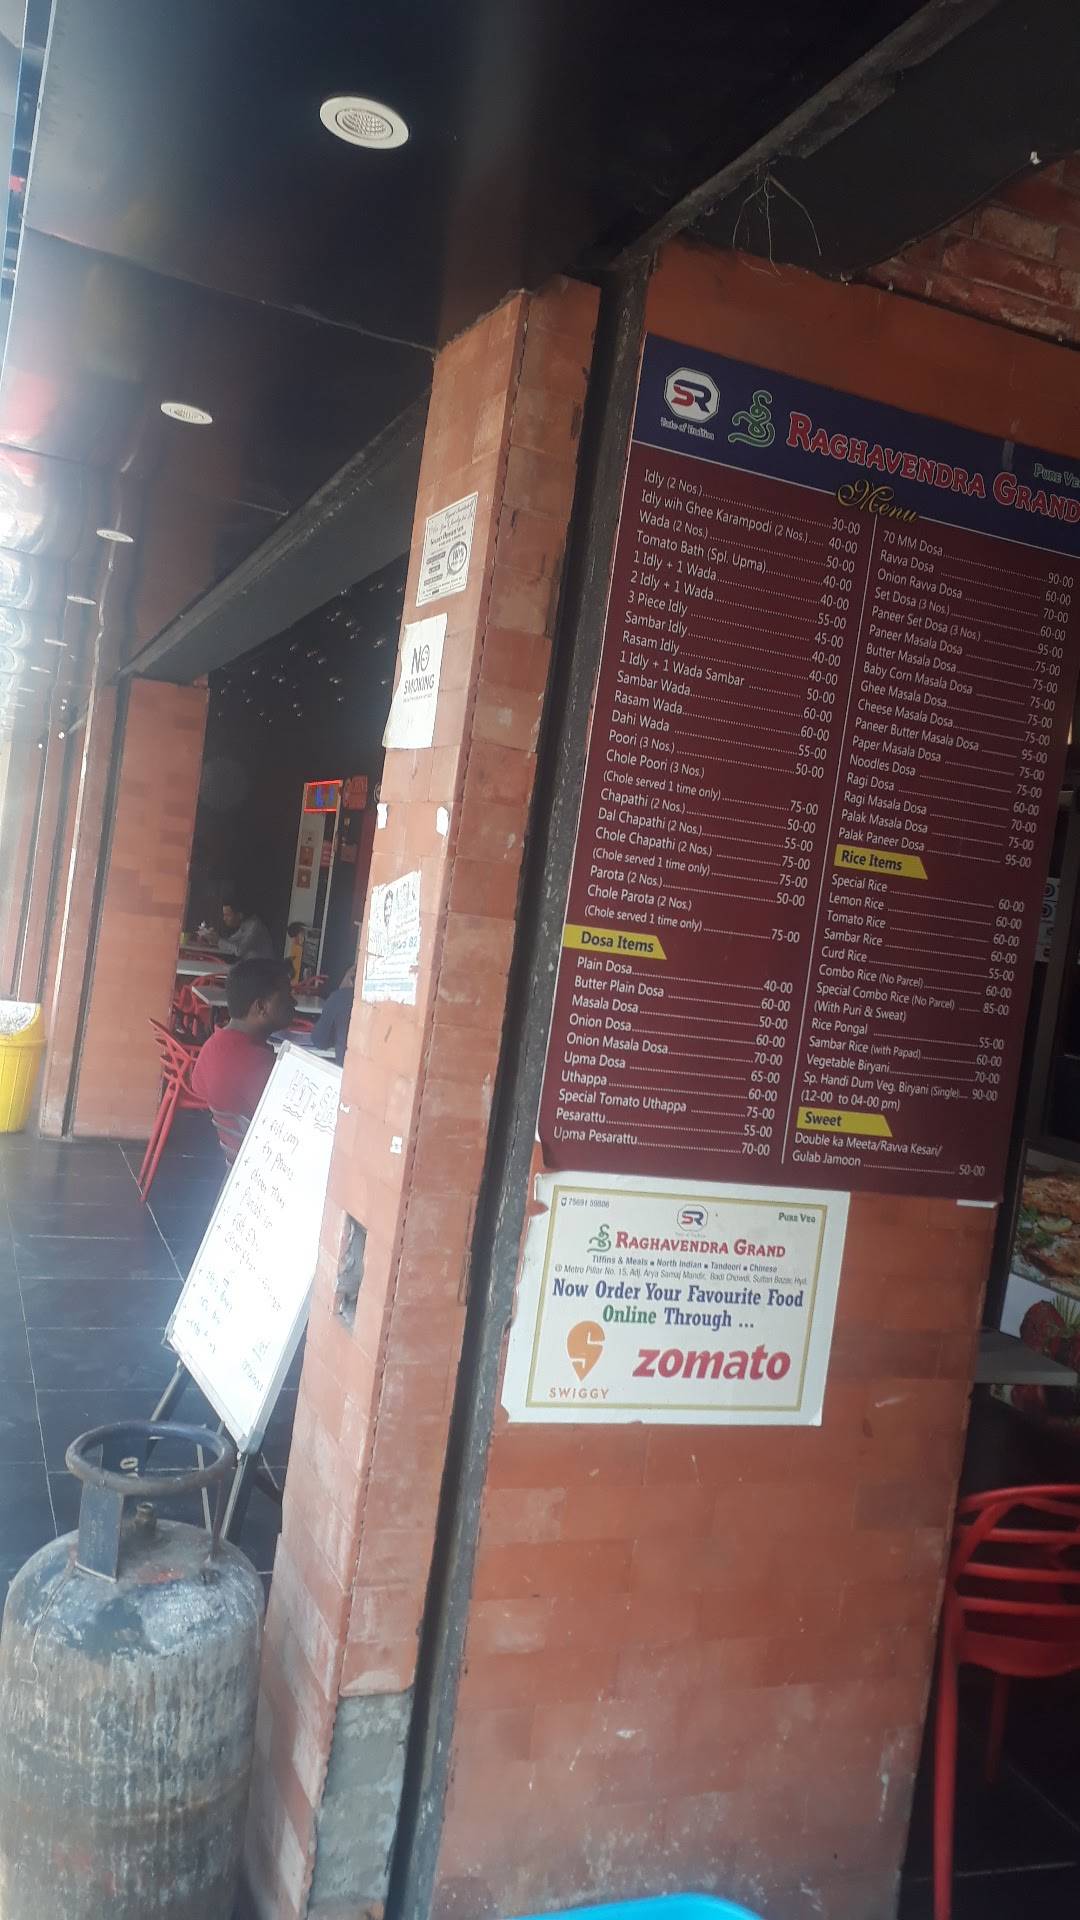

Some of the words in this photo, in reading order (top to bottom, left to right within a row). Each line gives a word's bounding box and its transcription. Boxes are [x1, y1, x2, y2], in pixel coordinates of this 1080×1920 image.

[643, 468, 664, 489] Idly
[785, 411, 986, 498] RAGHAVENDRA
[992, 471, 1080, 523] GRAND
[640, 488, 661, 508] Idly
[685, 500, 713, 519] Ghee
[715, 507, 772, 533] Karampodi
[838, 480, 920, 523] Menu
[636, 528, 677, 551] Tomato
[679, 539, 704, 557] Bath
[882, 529, 895, 544] 70
[896, 533, 917, 549] MM
[918, 539, 943, 556] Dosa
[876, 567, 907, 585] Onion
[908, 574, 937, 592] Ravva
[938, 581, 963, 599] Dosa
[624, 609, 666, 629] Sambar
[667, 618, 688, 638] Idly
[621, 629, 657, 649] Rasam
[659, 637, 680, 656] Idly
[411, 644, 431, 675] NO
[865, 641, 896, 658] Butter
[897, 649, 931, 667] Masala
[932, 656, 956, 672] Dosa
[404, 674, 435, 695] SMOKING
[616, 669, 658, 688] Sambar
[660, 678, 690, 696] Wada
[610, 708, 636, 725] Dahi
[639, 714, 670, 731] Wada
[605, 748, 637, 765] Chole
[639, 753, 667, 770] Poori
[849, 752, 889, 771] Noodles
[891, 760, 916, 776] Dosa
[597, 806, 616, 821] Dal
[618, 810, 665, 829] Chapathi
[840, 849, 866, 865] Rice
[868, 853, 902, 871] Items
[831, 872, 866, 889] Special
[867, 878, 888, 892] Rice
[826, 908, 864, 925] Tomato
[865, 914, 886, 929] Rice
[580, 930, 613, 947] Dosa
[616, 935, 654, 953] Items
[576, 955, 602, 970] Plain
[604, 959, 632, 974] Dosa
[574, 974, 607, 990] Butter
[609, 978, 635, 993] Plain
[637, 982, 664, 997] Dosa
[571, 993, 609, 1009] Masala
[611, 998, 639, 1013] Dosa
[568, 1012, 602, 1028] Onion
[604, 1016, 632, 1031] Dosa
[566, 1031, 599, 1046] Onion
[601, 1034, 639, 1051] Masala
[641, 1039, 668, 1054] Dosa
[563, 1050, 596, 1066] Upma
[598, 1053, 626, 1068] Dosa
[806, 1052, 856, 1070] Vegetable
[857, 1058, 890, 1074] Biryani
[561, 1069, 607, 1087] Uthappa
[558, 1087, 596, 1104] Special
[599, 1091, 640, 1107] Tomato
[642, 1096, 687, 1114] Uthappa
[555, 1106, 606, 1123] Pesarattu
[804, 1110, 842, 1127] Sweet
[553, 1125, 586, 1141] Upma
[588, 1128, 637, 1145] Pesarattu
[794, 1131, 830, 1146] Double
[832, 1134, 843, 1147] ka
[791, 1148, 821, 1163] Gulab
[615, 1231, 729, 1254] RAGHAVENDRA
[733, 1238, 786, 1258] GRAND
[626, 1256, 648, 1266] Meals
[657, 1258, 677, 1267] North
[679, 1259, 702, 1268] Indian
[711, 1261, 741, 1271] Tandoori
[552, 1278, 589, 1298] Now
[595, 1279, 641, 1300] Order
[645, 1282, 682, 1302] Your
[687, 1284, 761, 1306] Favourite
[766, 1288, 804, 1308] Food
[602, 1304, 657, 1324] Online
[664, 1307, 733, 1332] Through
[632, 1344, 791, 1380] zomato
[549, 1387, 609, 1401] SWIGGY
